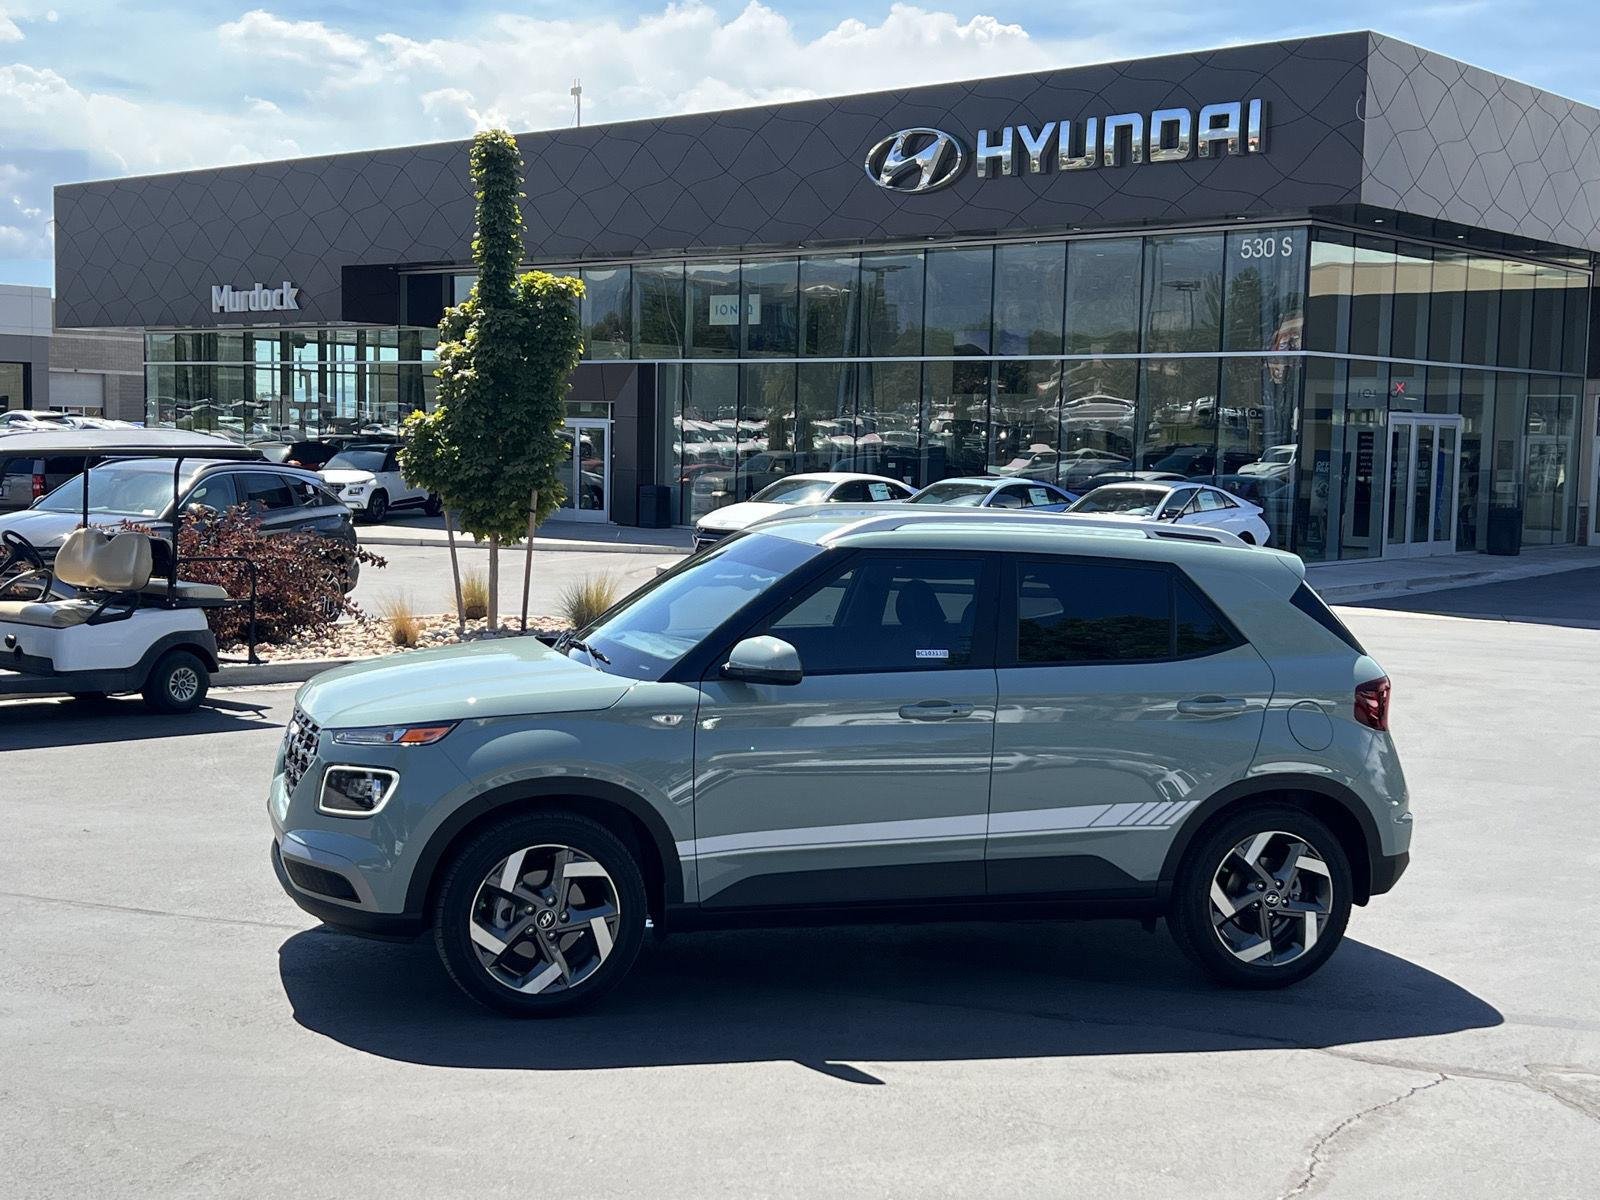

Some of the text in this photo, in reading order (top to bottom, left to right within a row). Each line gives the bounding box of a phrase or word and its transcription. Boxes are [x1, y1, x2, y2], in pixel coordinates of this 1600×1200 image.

[976, 98, 1264, 179] HYUNDAI
[1240, 236, 1293, 259] 530 S
[211, 281, 299, 313] Murdock
[715, 303, 753, 316] IONQ
